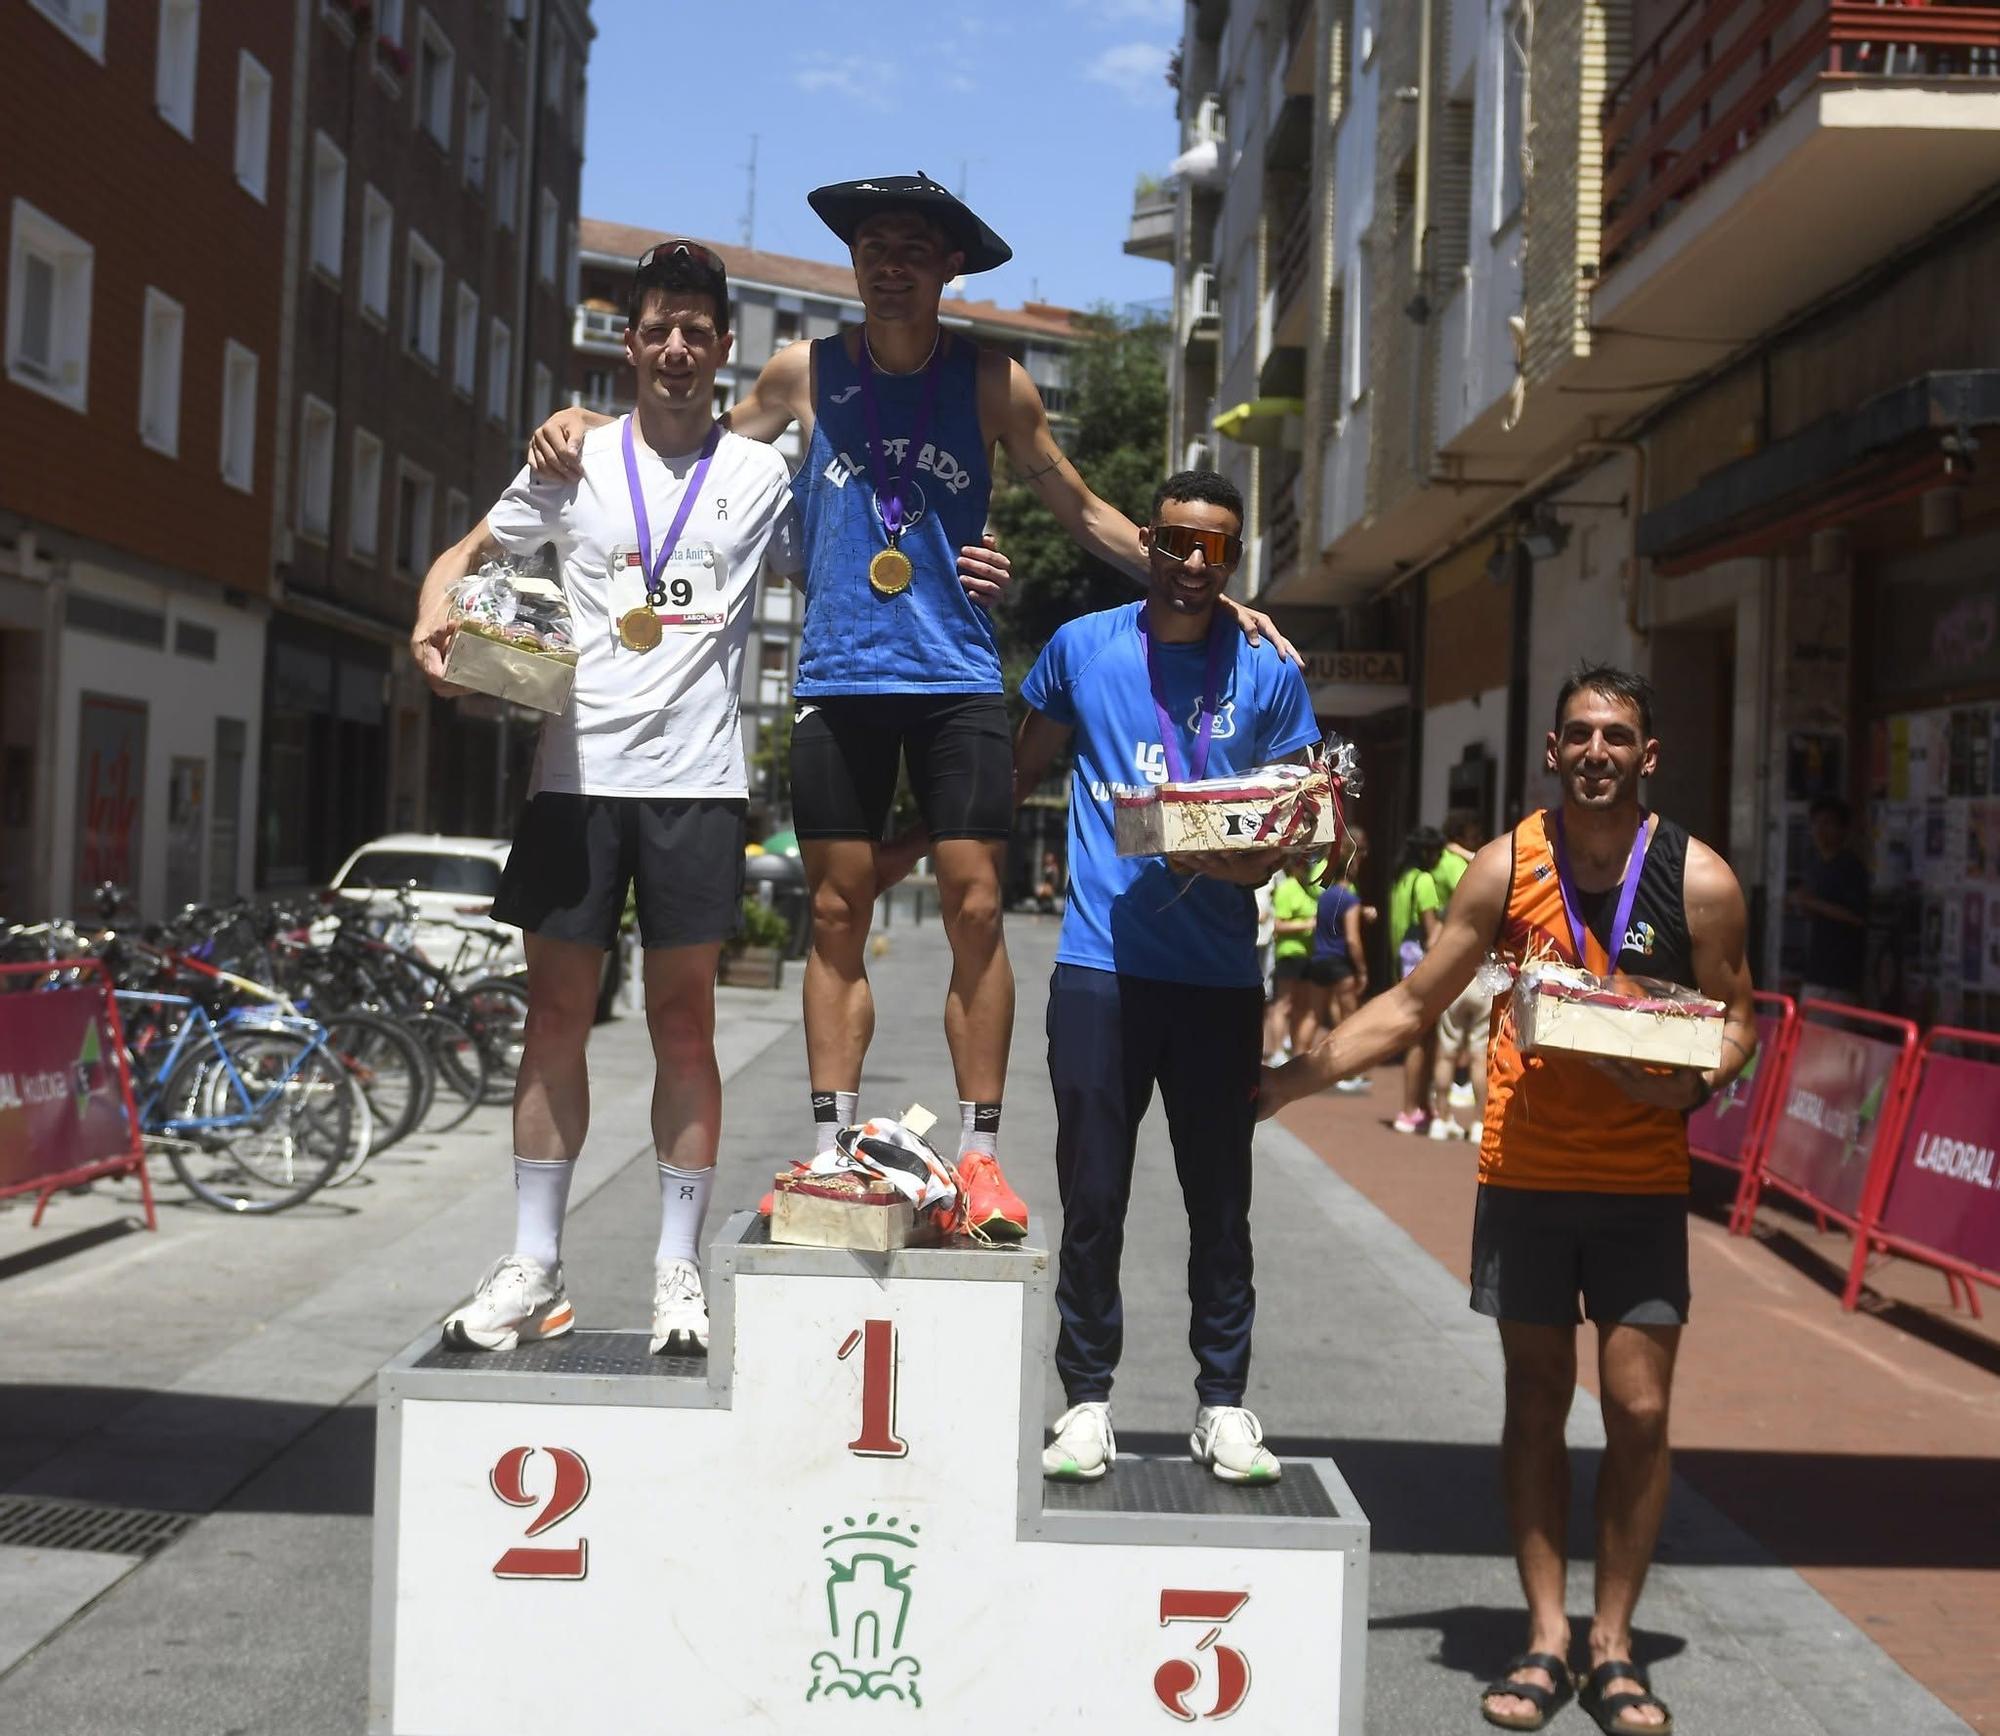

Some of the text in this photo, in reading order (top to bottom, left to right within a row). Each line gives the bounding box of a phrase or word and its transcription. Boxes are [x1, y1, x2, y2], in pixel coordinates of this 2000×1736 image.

[823, 452, 865, 488] EL
[646, 578, 693, 607] 89
[1914, 1131, 1995, 1188] LABORAL
[837, 1319, 908, 1459] 1
[490, 1444, 592, 1580] 2
[1153, 1589, 1252, 1722] 3
